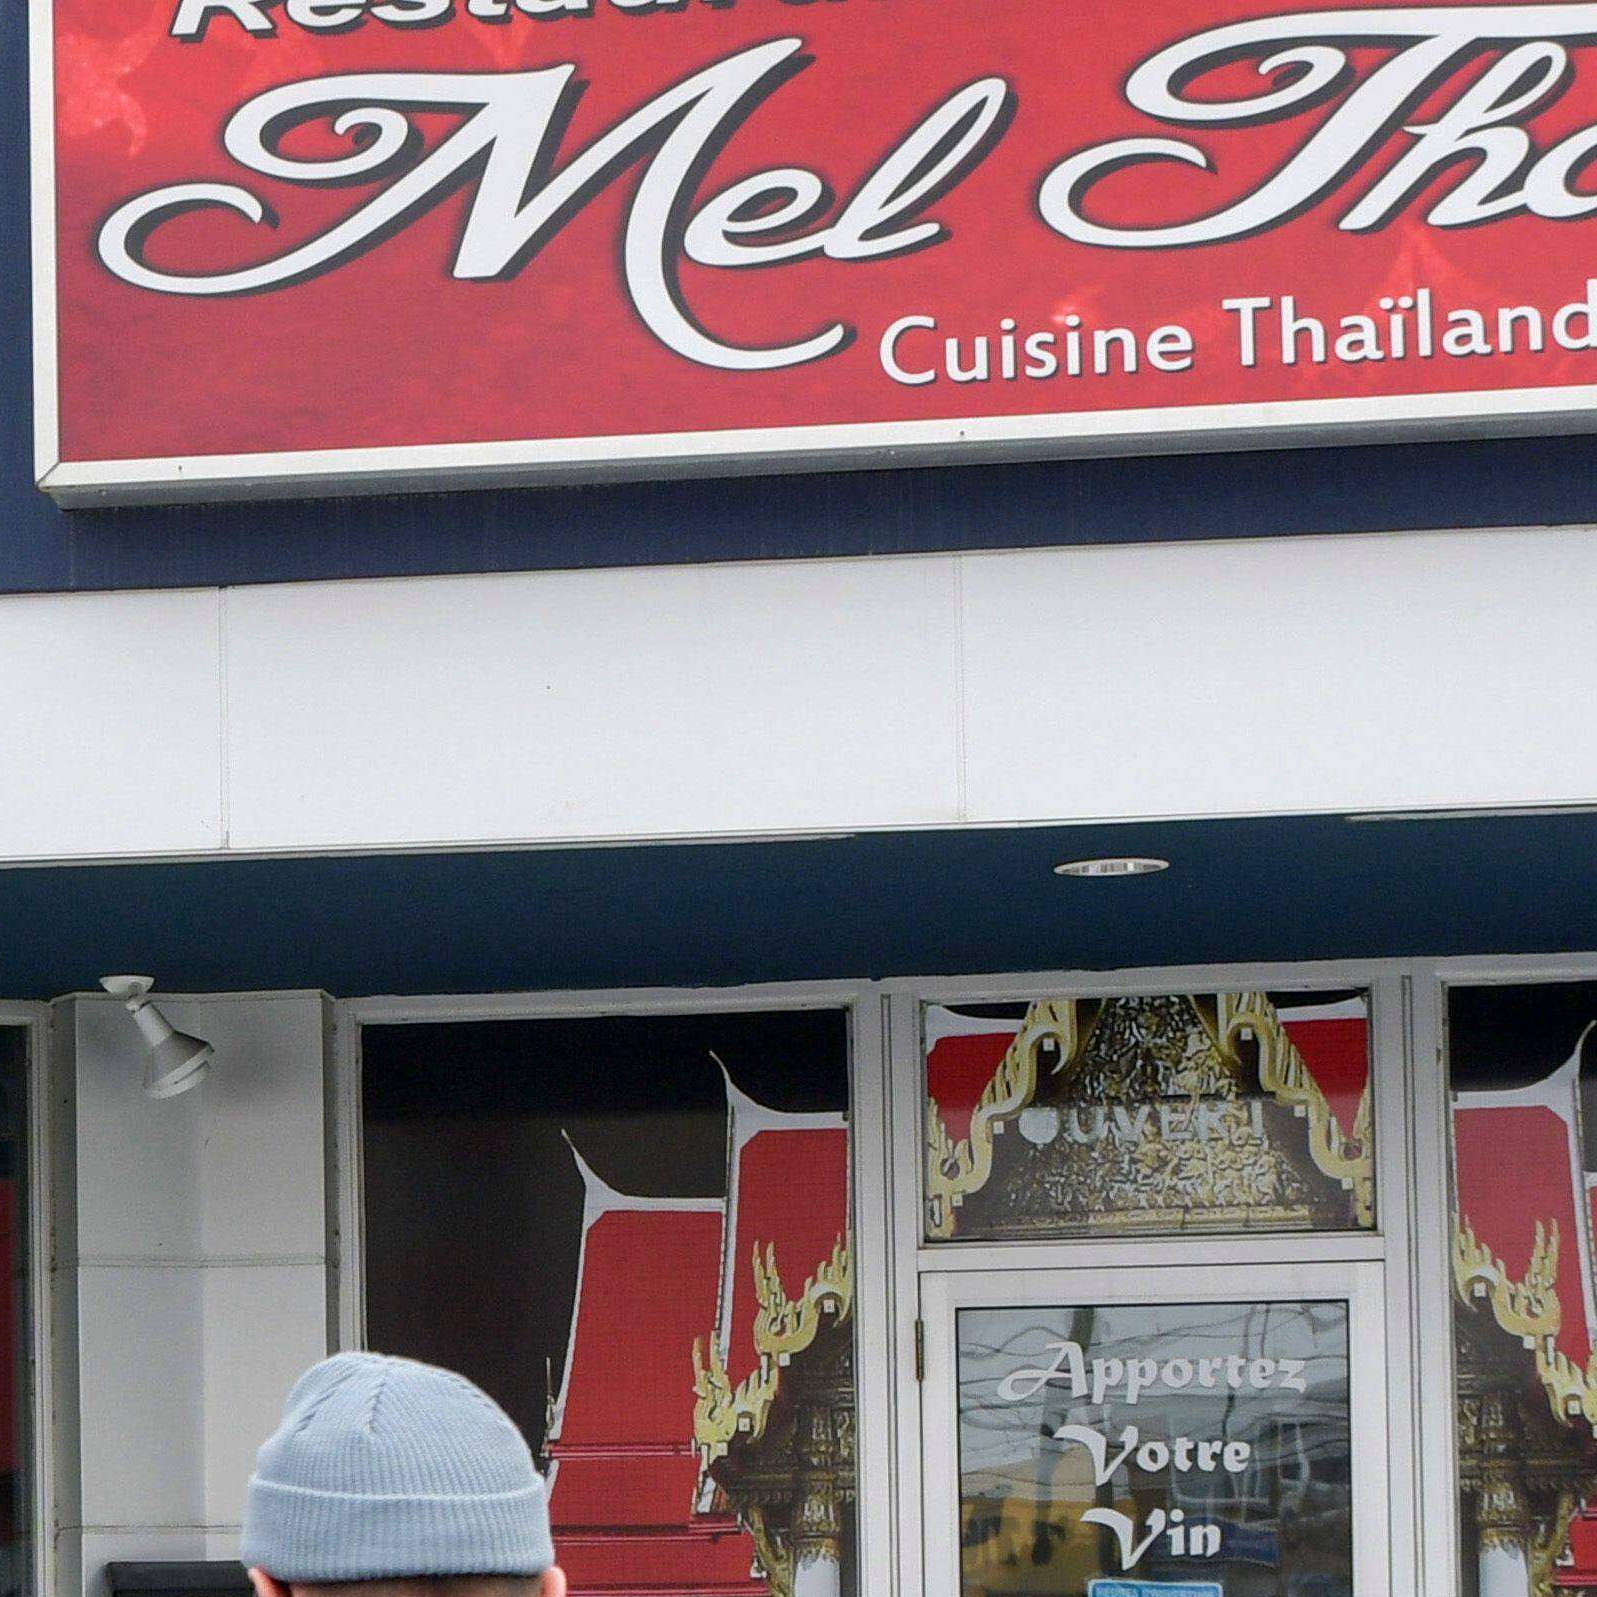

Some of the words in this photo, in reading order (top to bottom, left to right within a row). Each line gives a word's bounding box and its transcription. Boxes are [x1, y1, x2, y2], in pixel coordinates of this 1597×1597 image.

[96, 37, 1007, 370] Mel
[879, 313, 1194, 385] Cuisine
[1221, 278, 1597, 367] Thaïland
[996, 1340, 1307, 1405] Apportez
[1053, 1424, 1251, 1487] Votre
[1080, 1507, 1222, 1571] Vin
